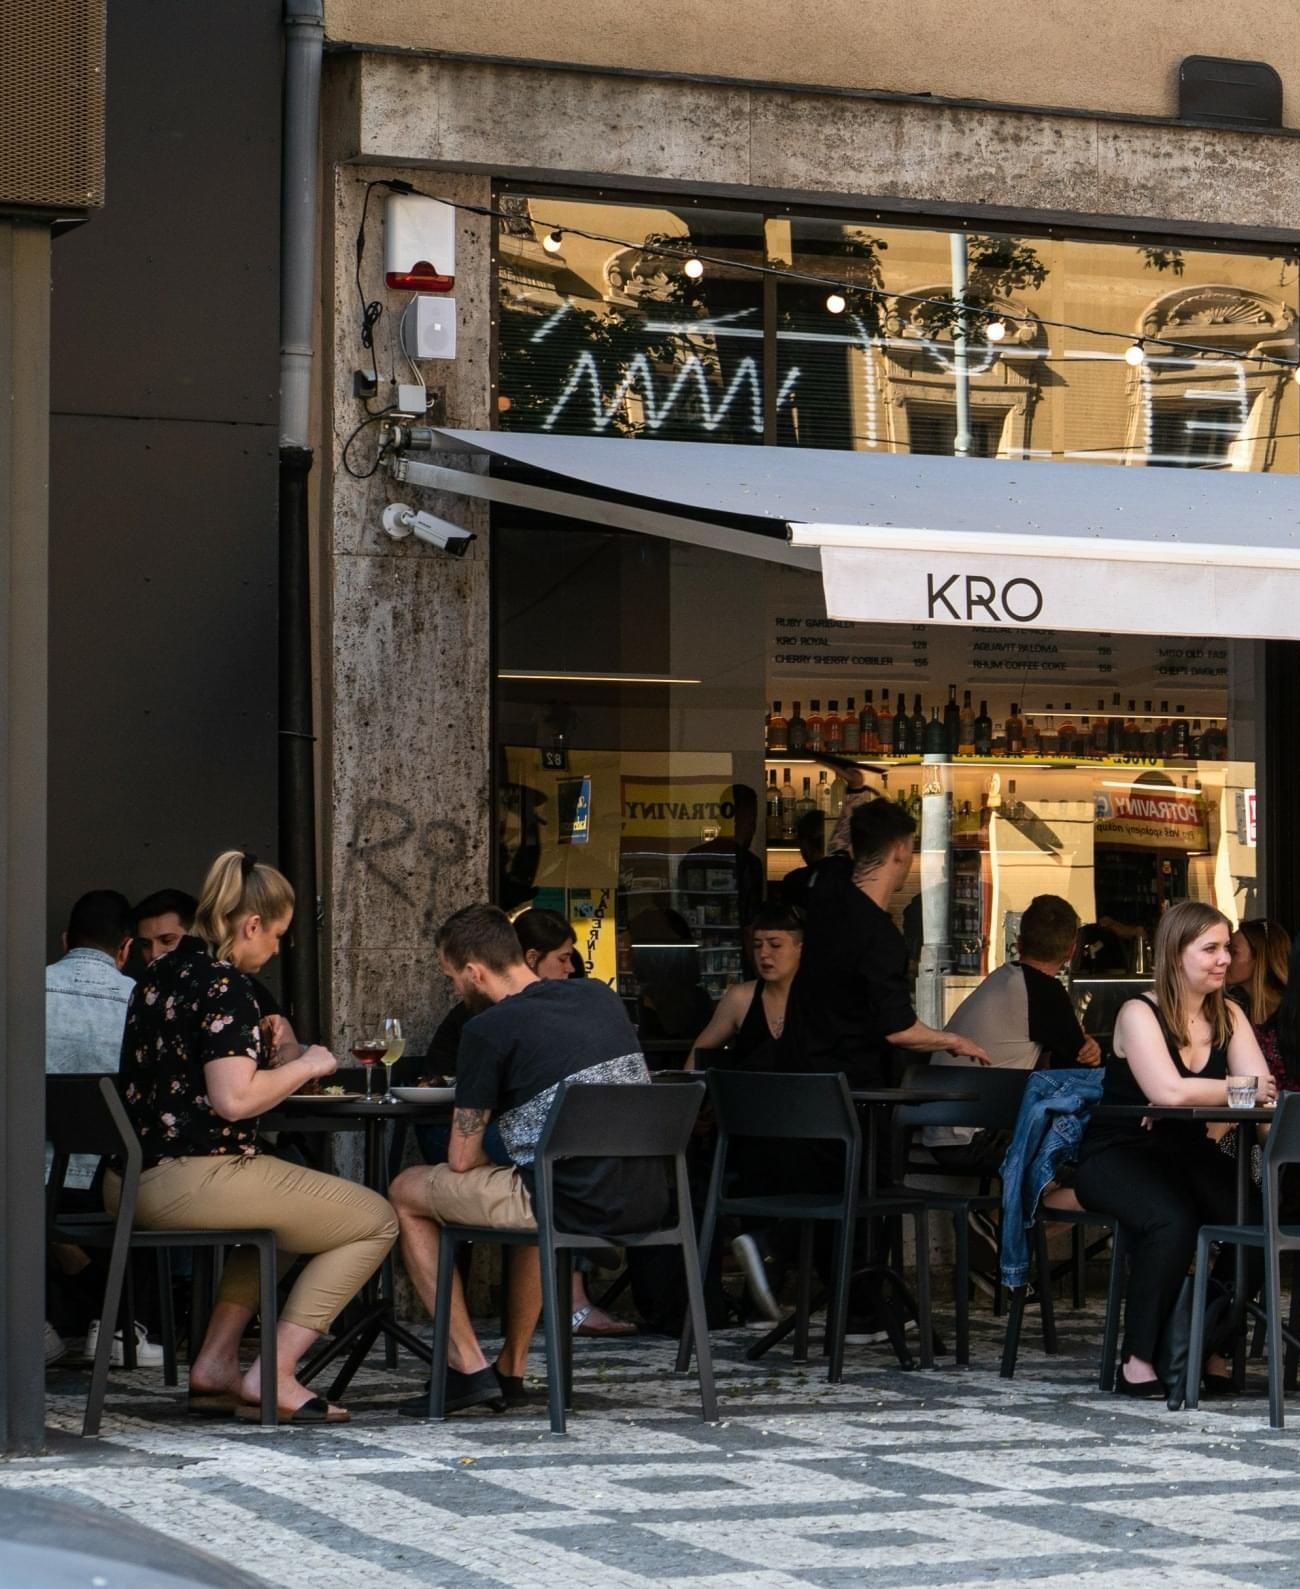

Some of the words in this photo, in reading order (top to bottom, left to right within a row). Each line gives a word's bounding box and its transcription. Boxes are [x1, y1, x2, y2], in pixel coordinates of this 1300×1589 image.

[927, 573, 1043, 622] KRO
[776, 636, 797, 646] KRO
[800, 637, 830, 646] ROYAL
[775, 655, 811, 664] CHERRY
[813, 655, 849, 665] SHERRY
